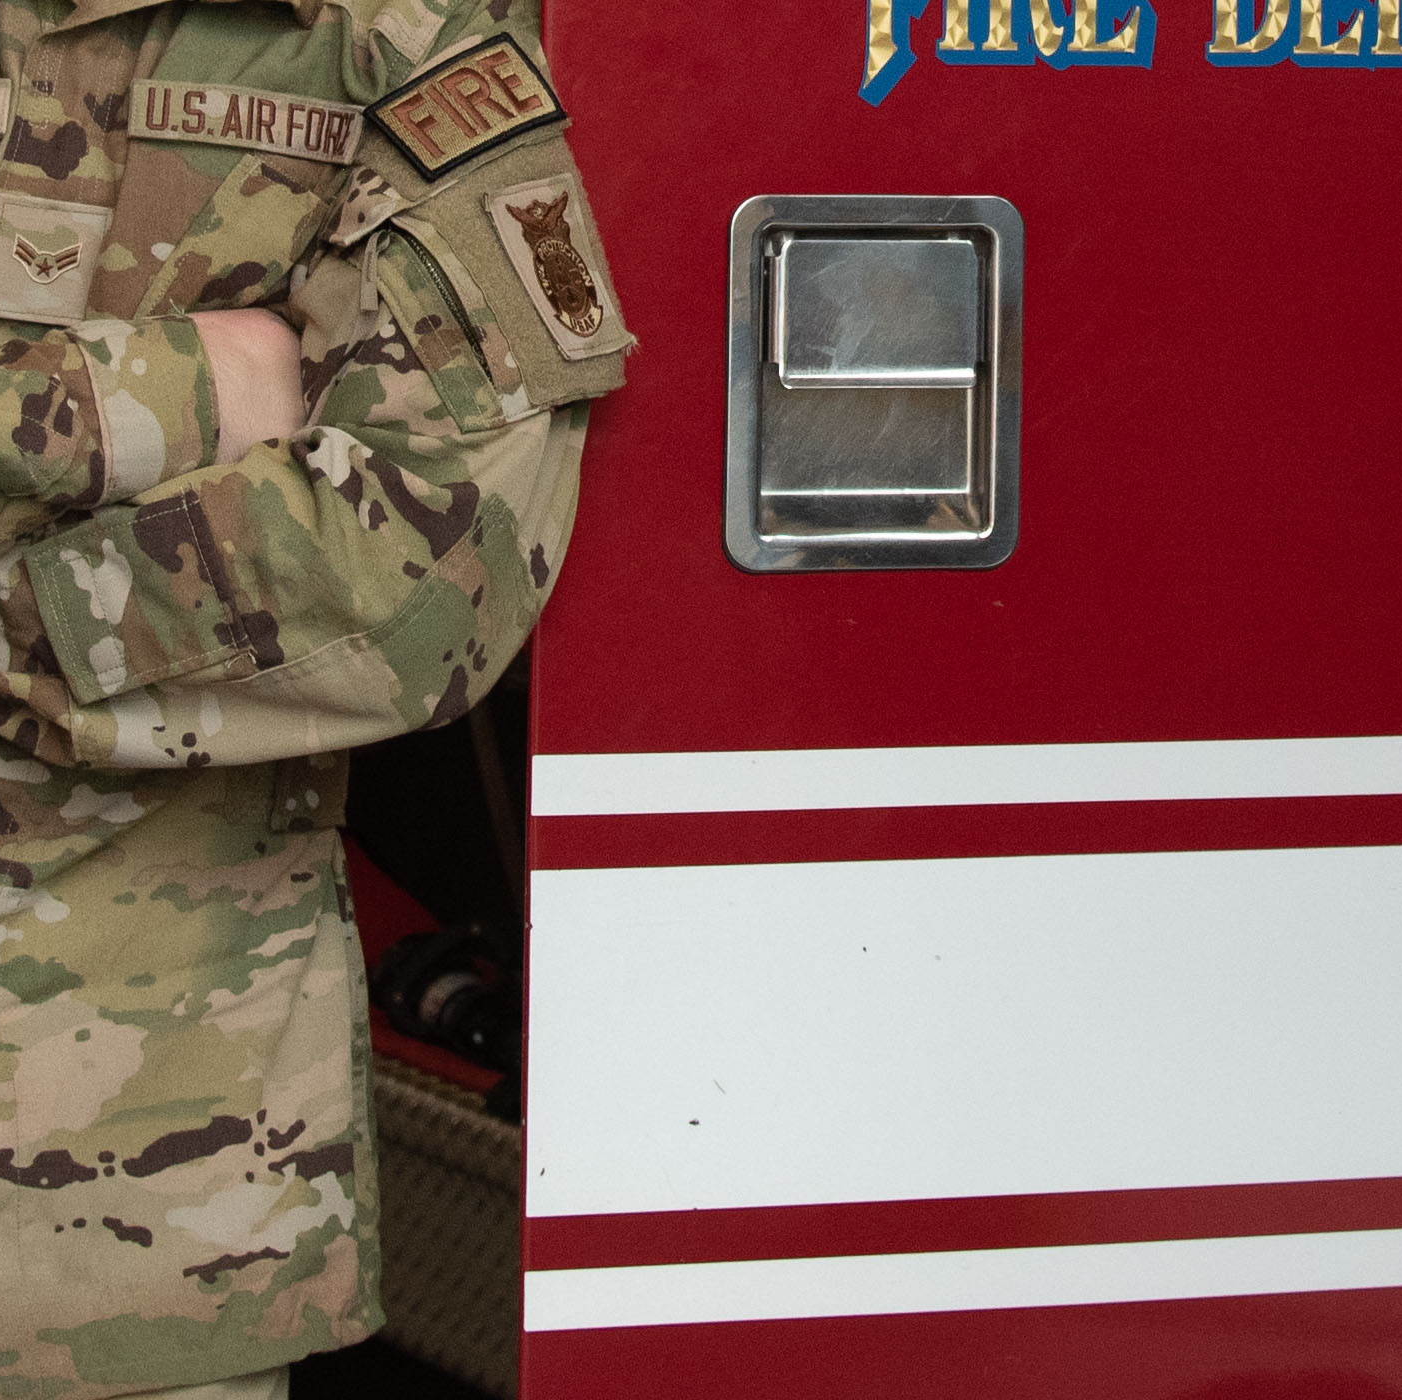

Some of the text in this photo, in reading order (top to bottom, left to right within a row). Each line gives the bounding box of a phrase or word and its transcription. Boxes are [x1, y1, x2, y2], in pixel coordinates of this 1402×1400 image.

[145, 87, 356, 157] U.S. AIR FOR
[390, 49, 544, 160] FIRE
[569, 313, 597, 333] USAF
